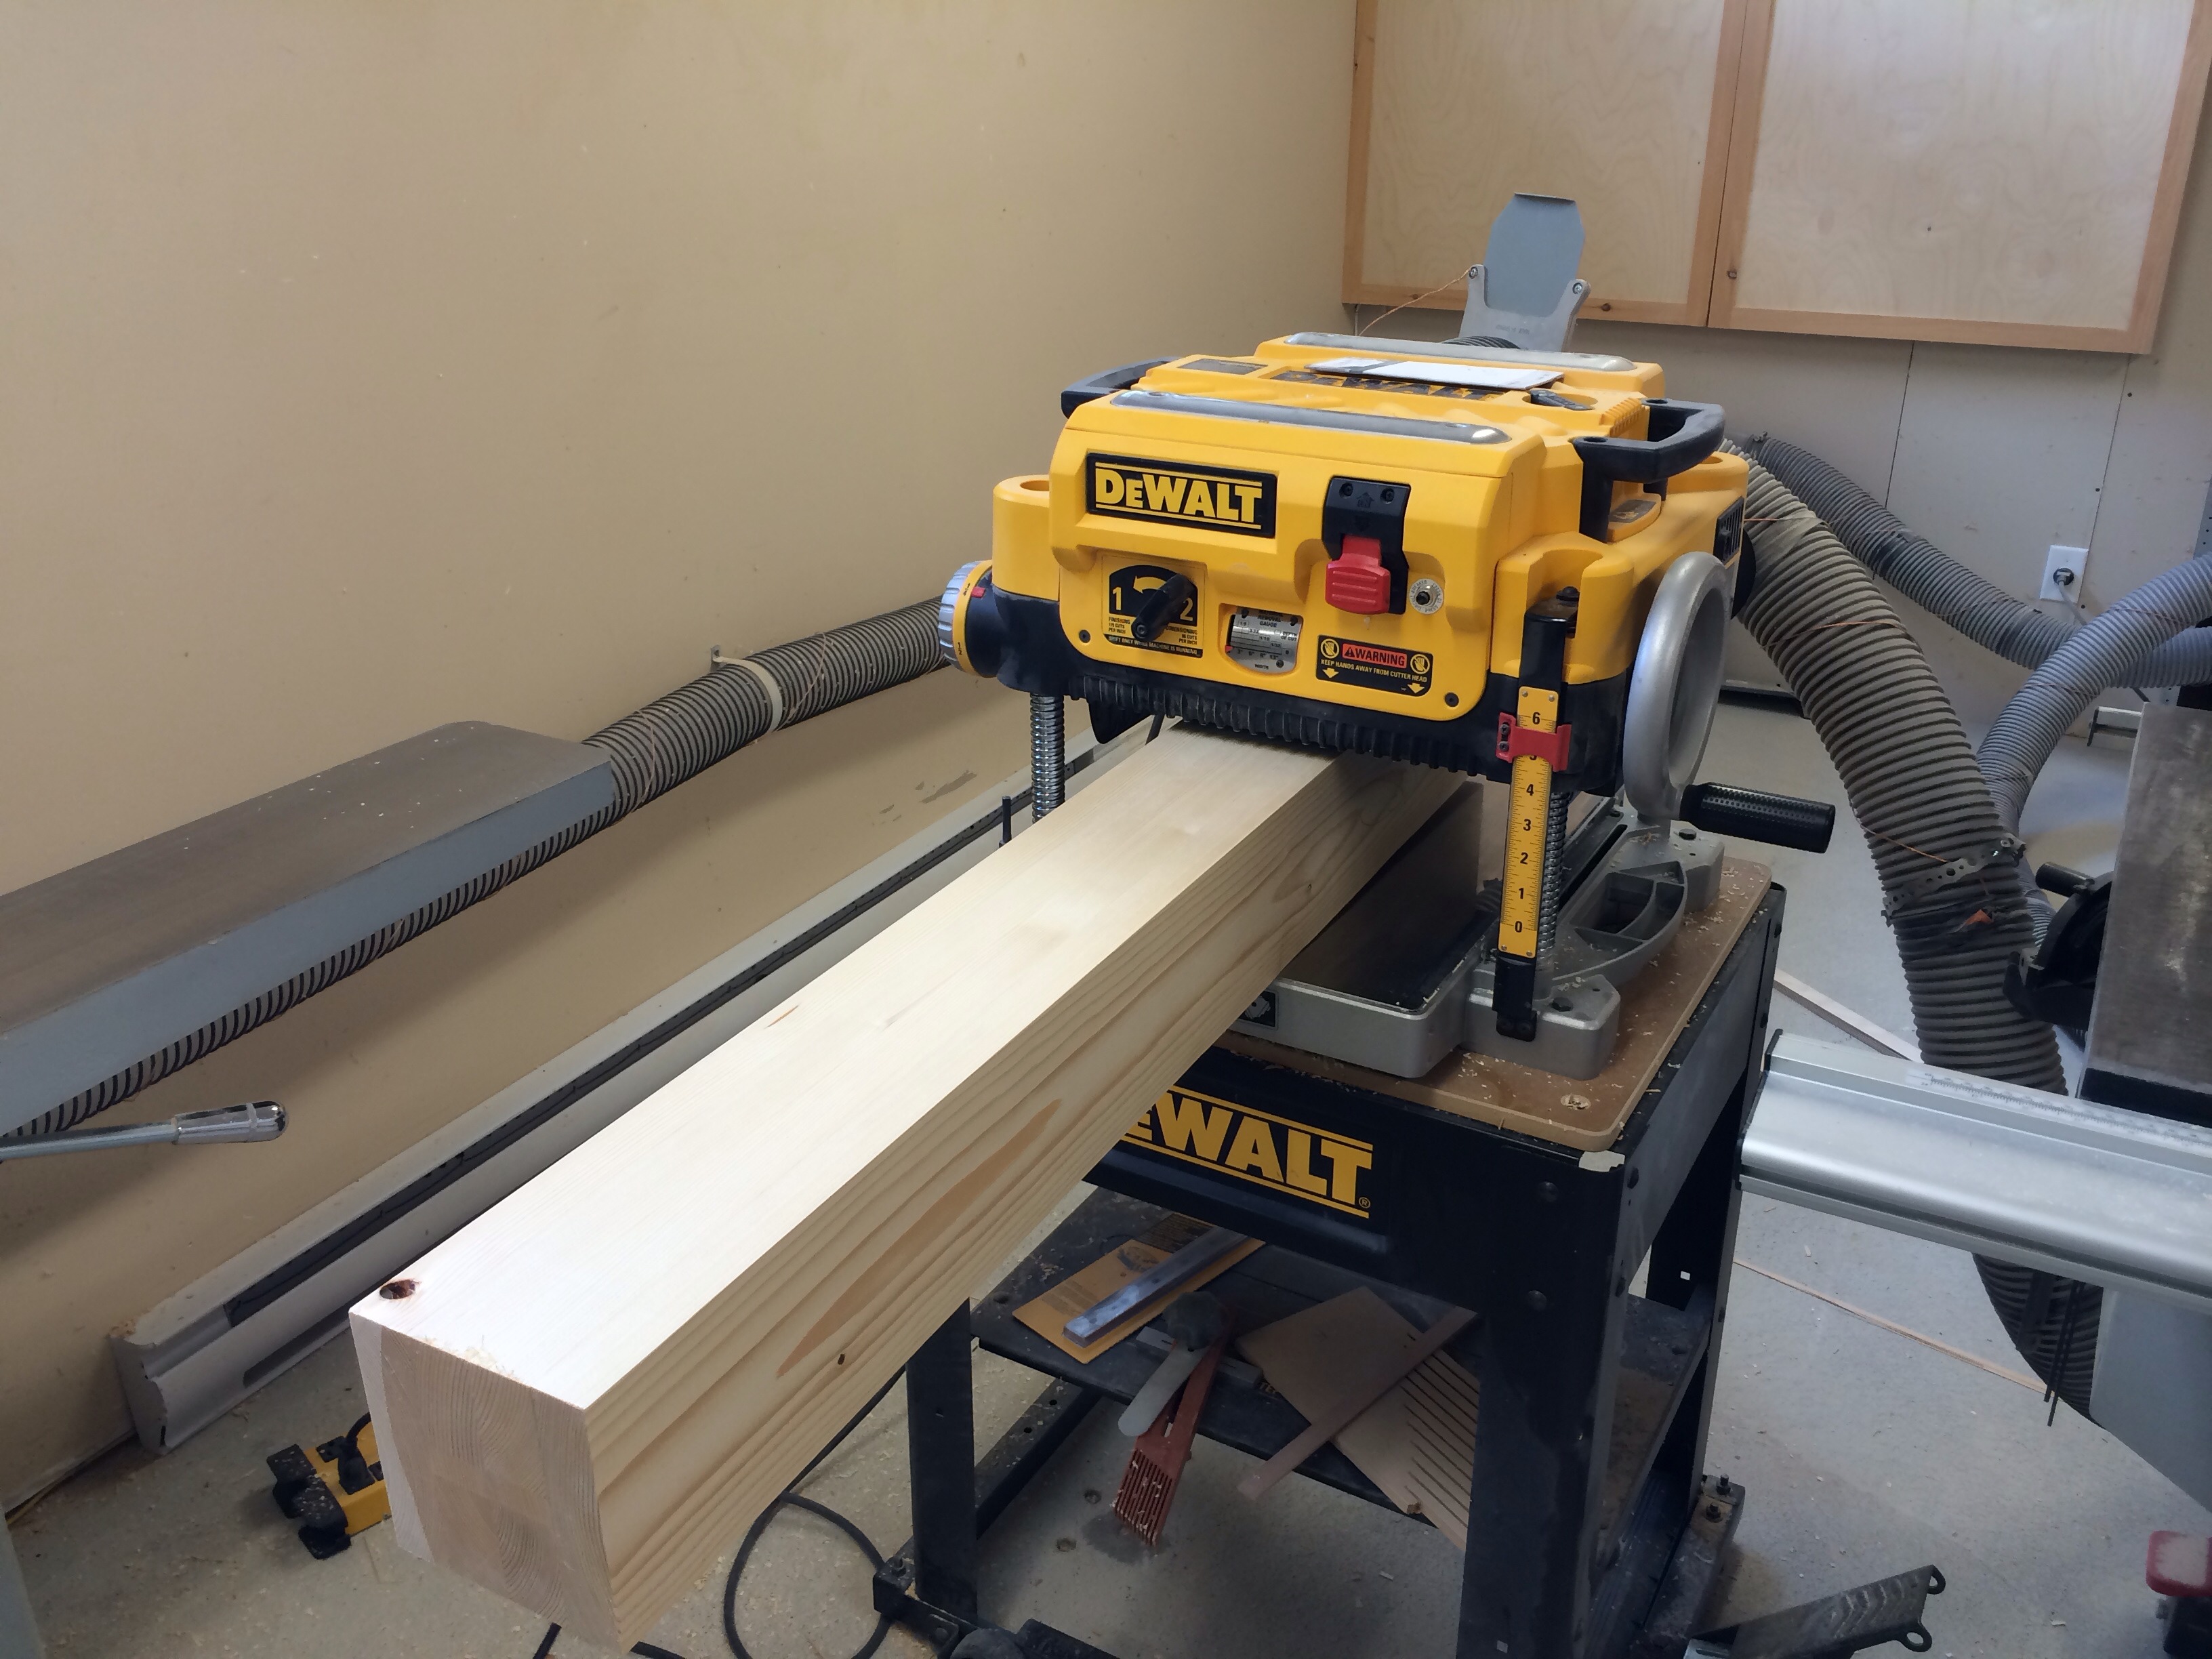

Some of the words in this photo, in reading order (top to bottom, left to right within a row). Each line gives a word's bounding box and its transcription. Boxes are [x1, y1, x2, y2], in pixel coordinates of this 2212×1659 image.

[1094, 468, 1263, 523] DEWALT
[1112, 587, 1122, 610] 1
[1180, 597, 1193, 621] 2
[1355, 648, 1405, 666] WARNING
[1336, 661, 1354, 670] HANDS
[1355, 665, 1372, 673] AWAY
[1374, 668, 1389, 676] FROM
[1390, 671, 1411, 680] CUTTER
[1532, 712, 1540, 724] 6
[1525, 783, 1534, 796] 4
[1523, 819, 1532, 831] 3
[1520, 852, 1528, 865] 2
[1519, 888, 1525, 900] 1
[1515, 921, 1523, 933] 0
[1125, 1090, 1373, 1205] EWALT
